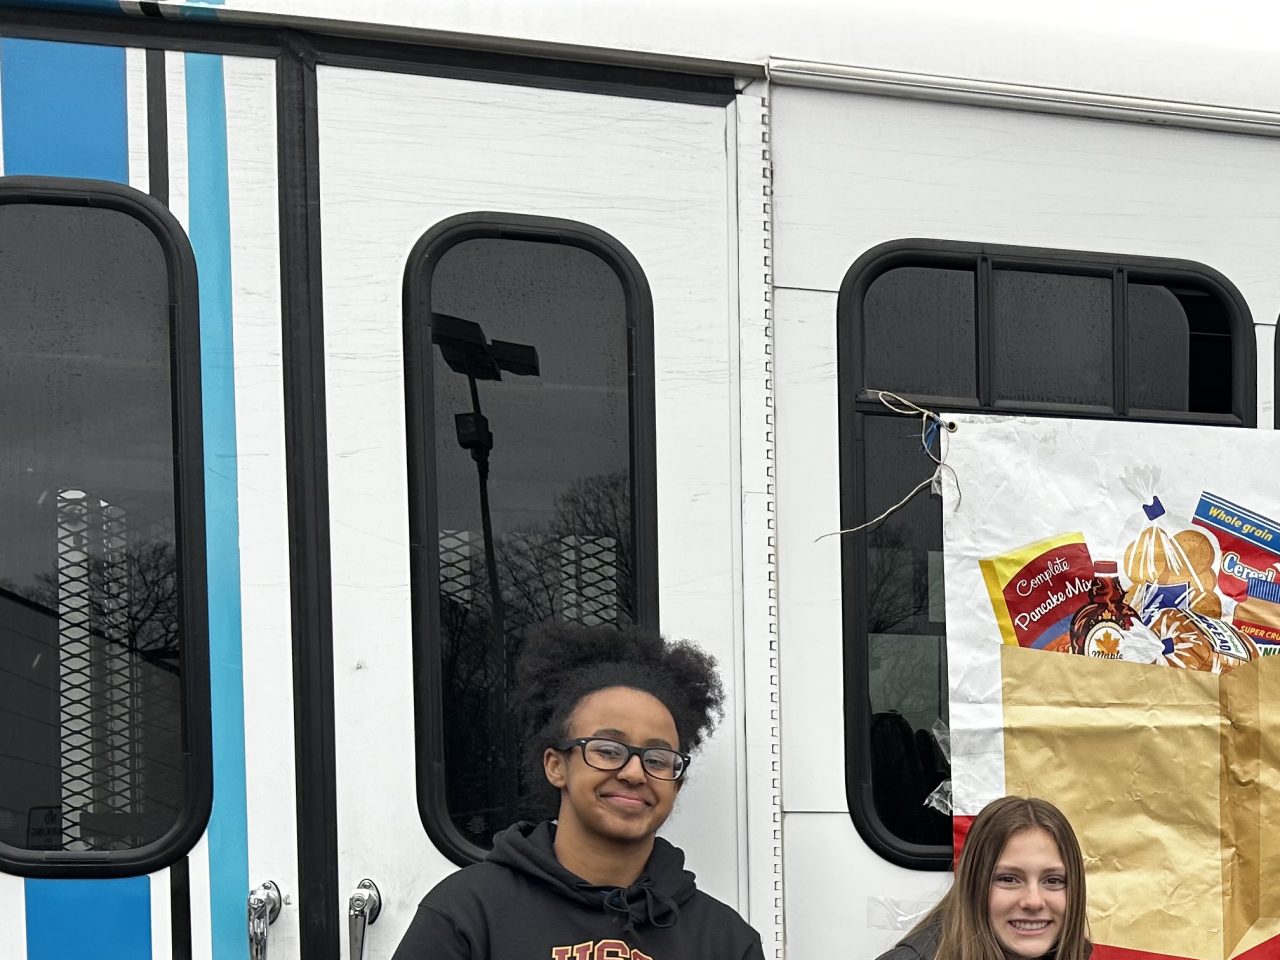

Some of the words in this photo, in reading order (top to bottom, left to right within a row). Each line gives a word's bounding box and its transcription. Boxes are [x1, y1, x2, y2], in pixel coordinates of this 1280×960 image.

[1208, 506, 1243, 528] Whole
[1241, 523, 1274, 542] grain
[1016, 556, 1070, 598] Complete
[1222, 552, 1276, 582] Cereal
[1014, 590, 1067, 632] Pancake
[1065, 576, 1094, 599] Mix
[1239, 624, 1266, 638] SUPER
